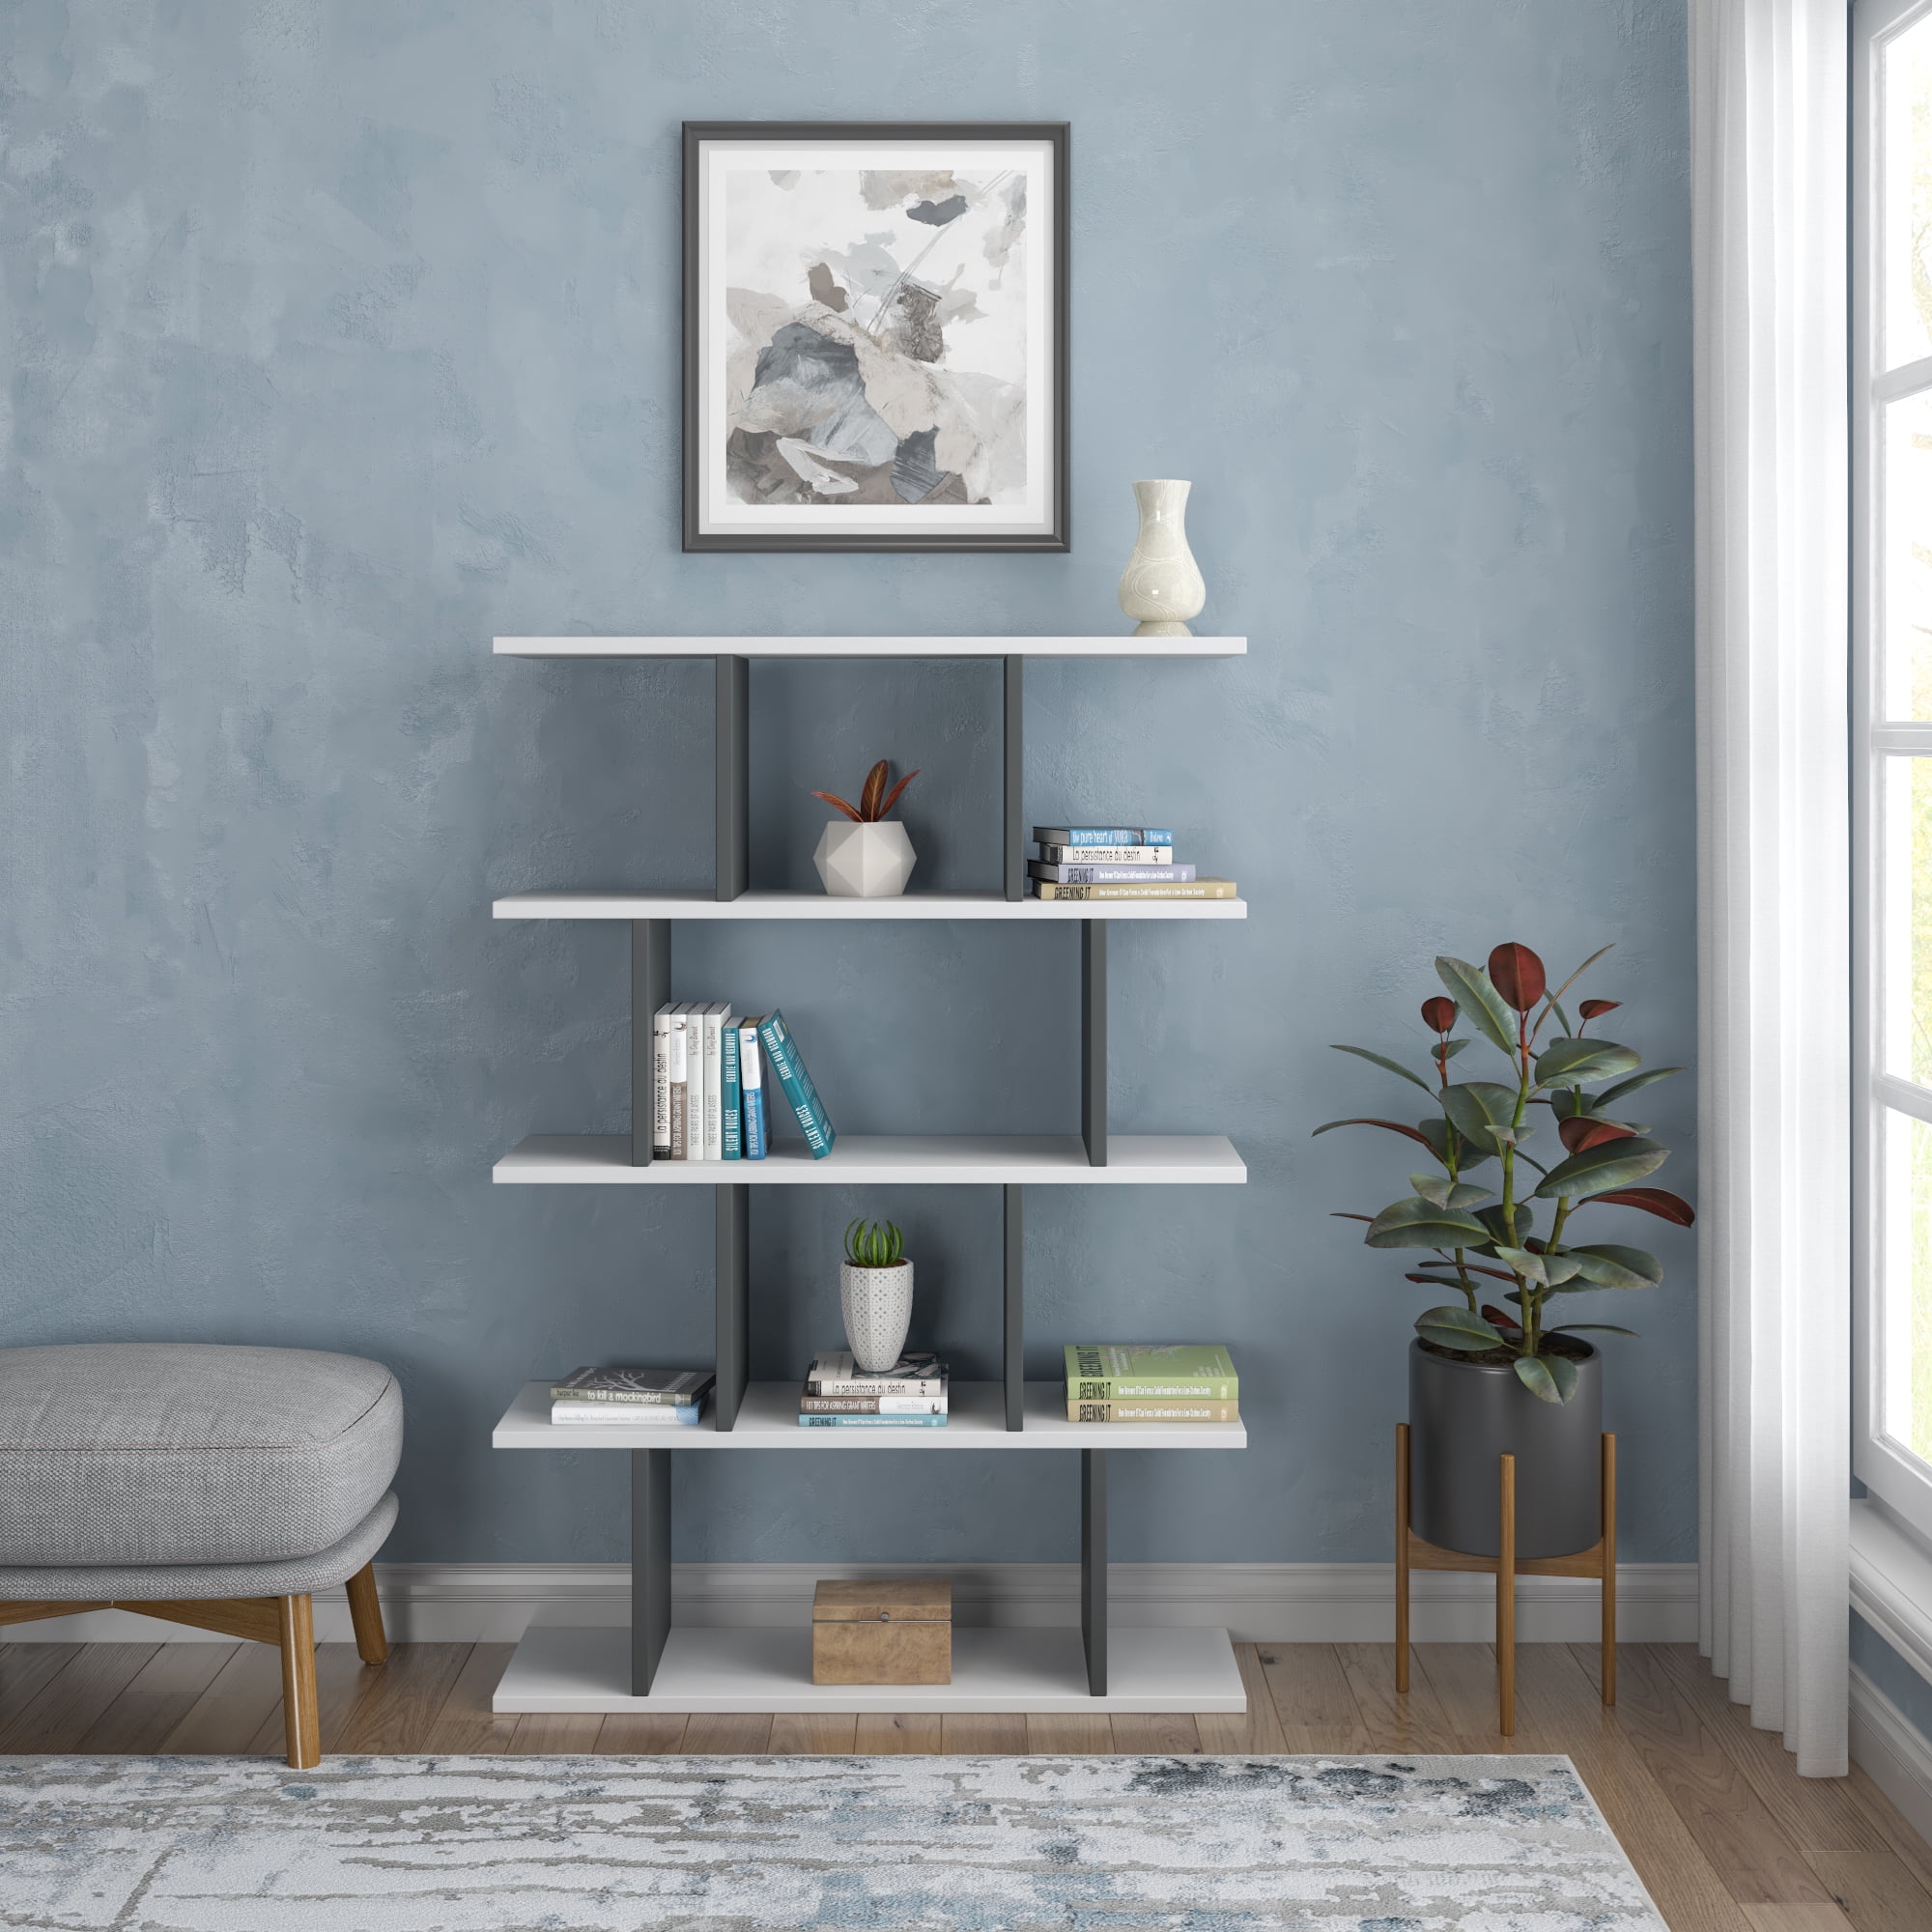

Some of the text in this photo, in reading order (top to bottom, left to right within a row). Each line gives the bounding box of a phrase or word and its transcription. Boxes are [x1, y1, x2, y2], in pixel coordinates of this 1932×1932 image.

[1080, 832, 1094, 844] pure
[1072, 847, 1079, 861] La
[1055, 887, 1084, 899] GREENING
[1085, 887, 1092, 899] IT
[655, 1053, 668, 1072] destin
[795, 1104, 813, 1127] VOICES
[726, 1109, 738, 1151] SILENT VOICES
[805, 1125, 824, 1150] SILENT
[833, 1381, 838, 1394] La
[841, 1381, 876, 1396] persistance
[877, 1381, 885, 1394] du
[887, 1381, 906, 1394] destin
[1079, 1381, 1105, 1400] GREENING
[1105, 1381, 1111, 1400] IT
[587, 1391, 595, 1400] to
[597, 1390, 607, 1400] kill
[615, 1392, 661, 1405] mockingbird
[1079, 1405, 1105, 1422] GREENING
[1105, 1405, 1111, 1422] IT
